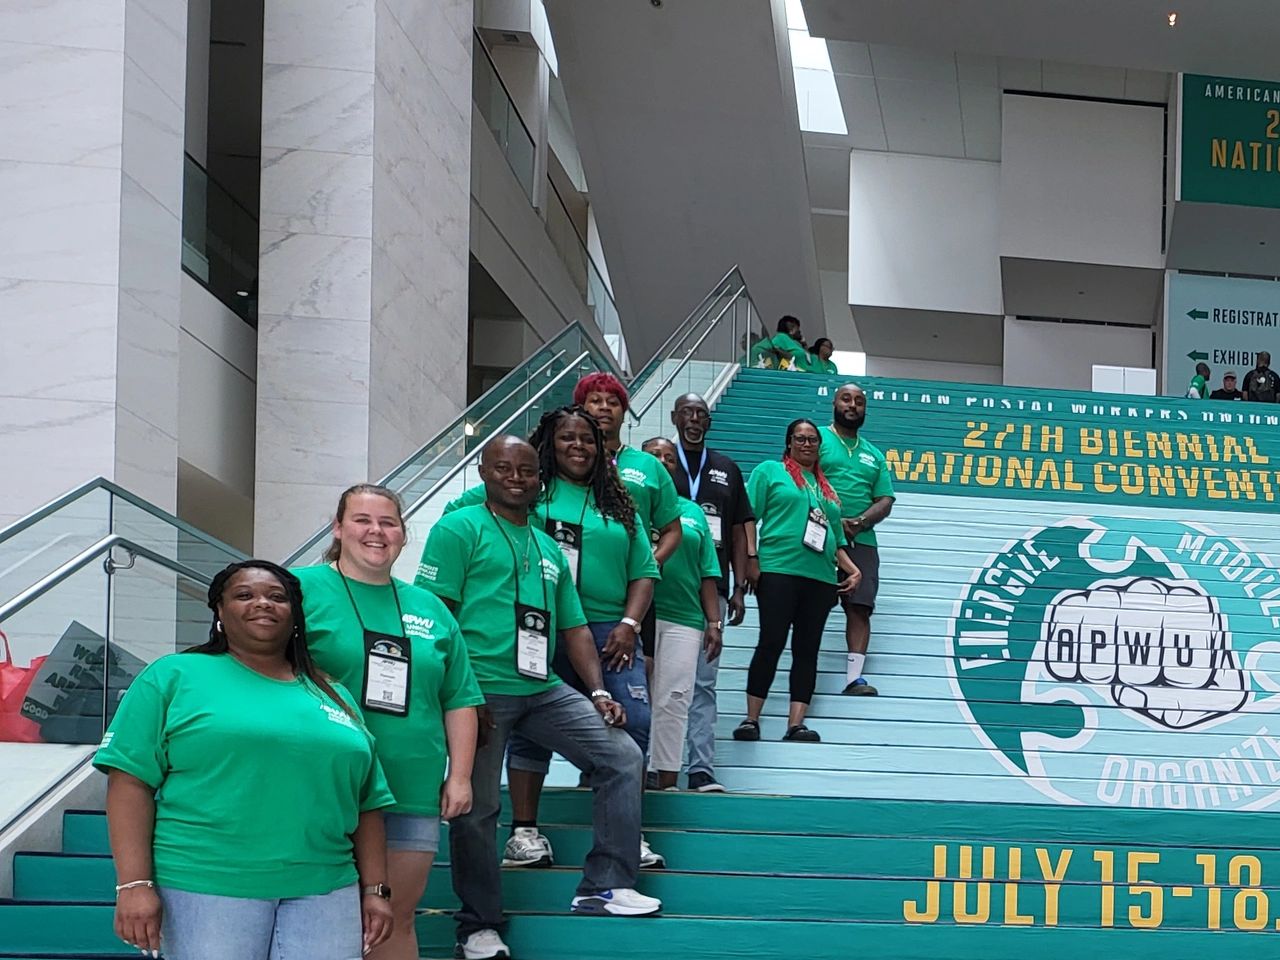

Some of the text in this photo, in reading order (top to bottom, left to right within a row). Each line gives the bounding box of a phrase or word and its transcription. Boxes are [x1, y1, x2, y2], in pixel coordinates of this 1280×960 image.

[1205, 84, 1280, 104] AMERICAN
[963, 421, 1270, 464] 27TH BIENNIAL
[885, 448, 1084, 492] NATIONAL
[958, 539, 1062, 671] ENERGIZE
[1056, 628, 1194, 668] APWU
[903, 844, 1074, 926] JULY
